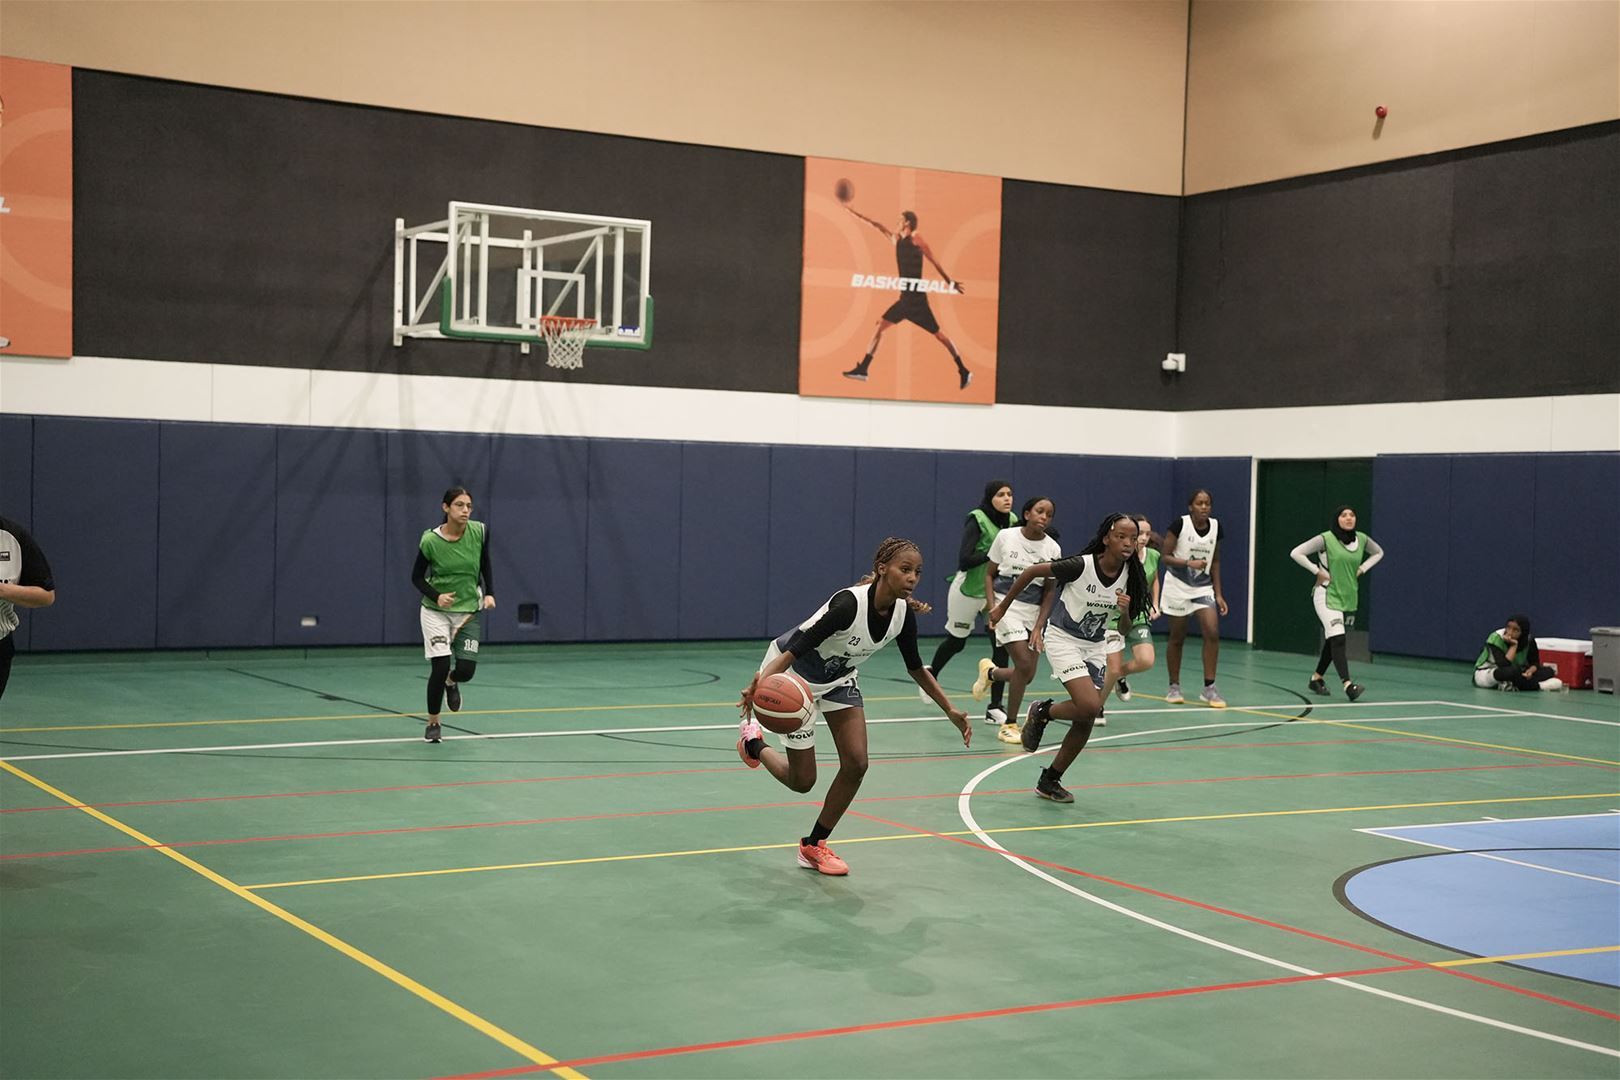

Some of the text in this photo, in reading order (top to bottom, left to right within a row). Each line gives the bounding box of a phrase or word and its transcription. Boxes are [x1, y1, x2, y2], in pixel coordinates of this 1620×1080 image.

[851, 274, 959, 294] BASKETBALL
[1086, 583, 1097, 594] 40
[1086, 601, 1118, 610] WOLVES
[848, 635, 861, 647] 23
